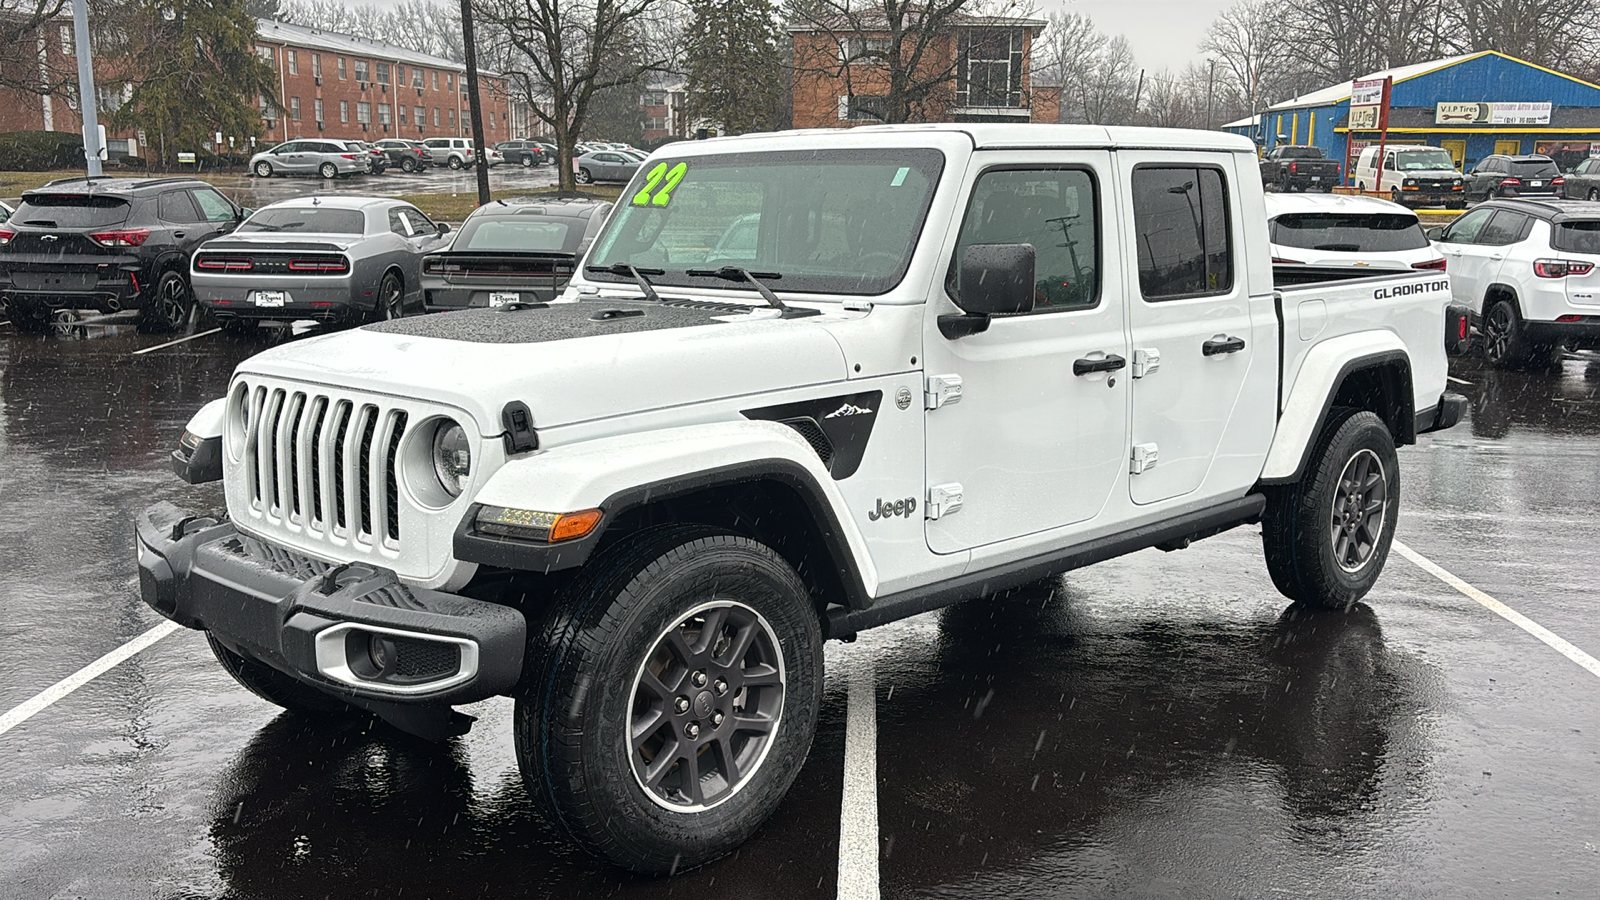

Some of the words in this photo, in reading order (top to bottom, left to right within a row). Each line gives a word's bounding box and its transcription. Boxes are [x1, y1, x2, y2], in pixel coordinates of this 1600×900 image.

[1459, 105, 1477, 113] Tires
[633, 162, 688, 207] 22
[1374, 280, 1449, 300] GLADIATOR
[868, 496, 917, 521] Jeep
